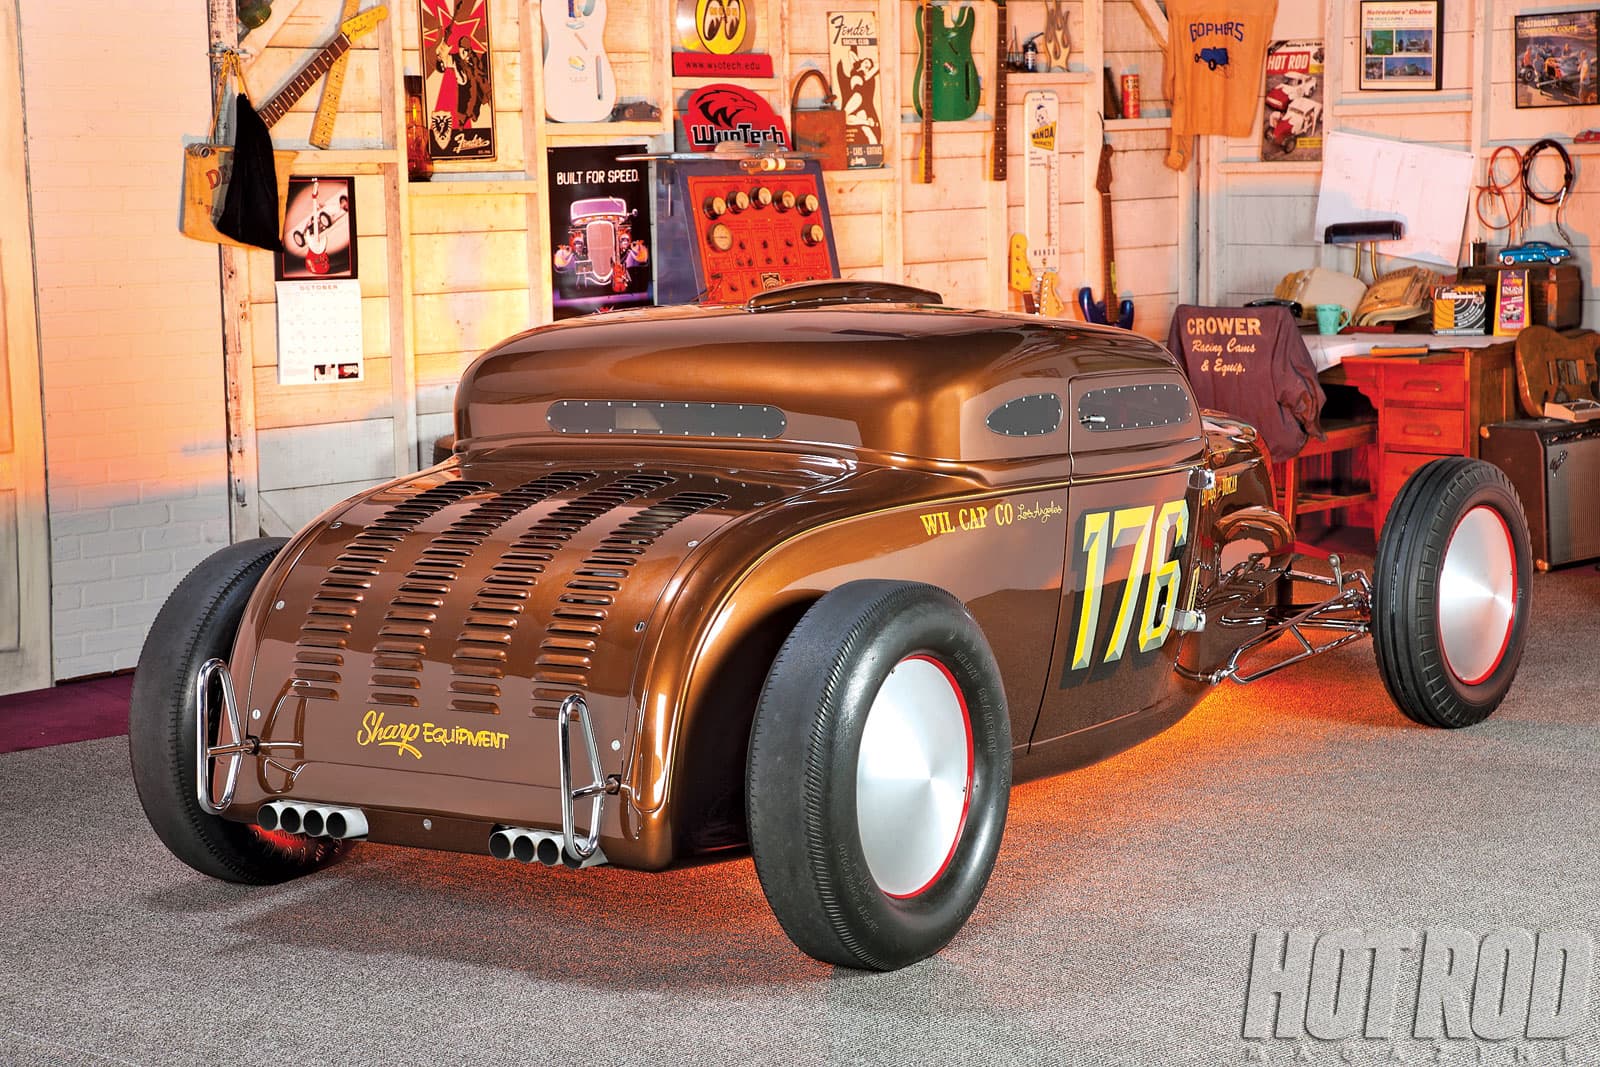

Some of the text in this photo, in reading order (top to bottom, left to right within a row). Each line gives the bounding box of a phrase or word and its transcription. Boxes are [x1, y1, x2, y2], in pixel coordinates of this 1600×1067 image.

[830, 15, 874, 44] Fender
[1267, 54, 1309, 70] HOT ROD
[556, 171, 583, 185] BUILT
[586, 171, 605, 184] FOR
[1187, 317, 1262, 336] CROWER
[1192, 337, 1256, 356] Racing Cams
[1201, 358, 1246, 376] & Equip.
[920, 513, 956, 537] WIL
[959, 507, 989, 531] CAP
[995, 503, 1013, 526] CO
[1071, 498, 1190, 672] 176
[357, 710, 423, 760] Sharp
